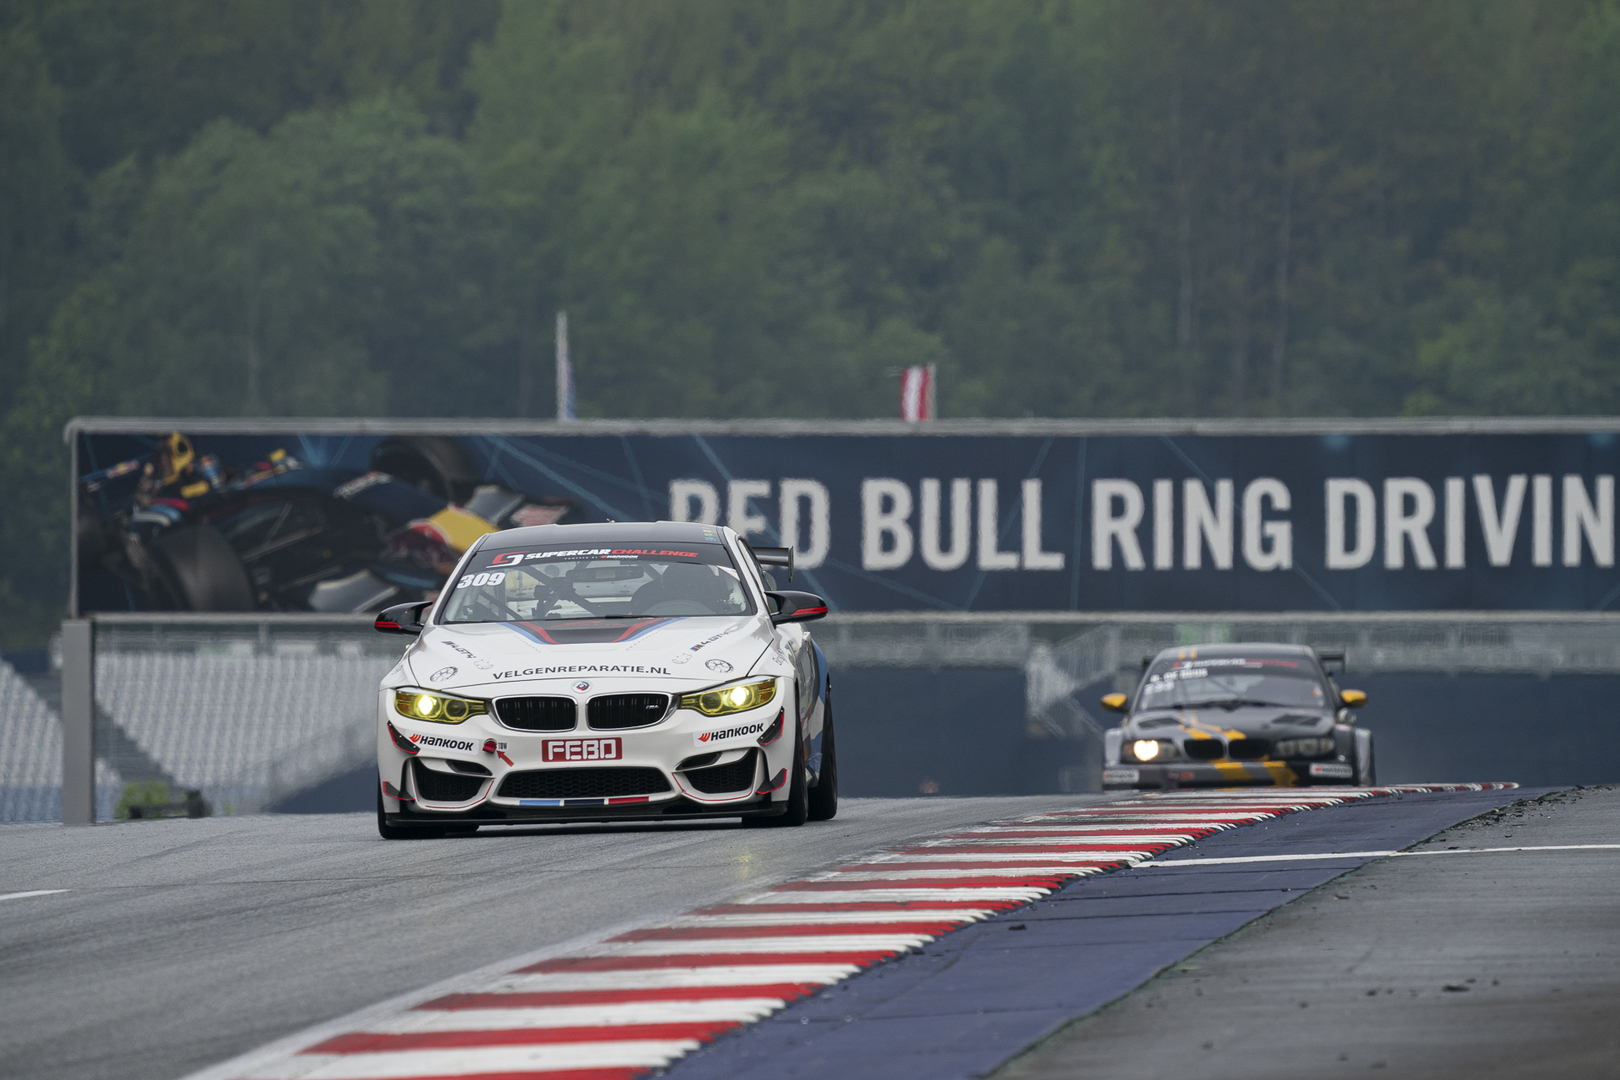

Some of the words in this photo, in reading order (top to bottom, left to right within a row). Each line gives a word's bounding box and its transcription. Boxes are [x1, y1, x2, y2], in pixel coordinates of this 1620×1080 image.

[860, 477, 1066, 571] BULL
[1091, 476, 1294, 572] RING
[1324, 474, 1616, 571] DRIVIN
[524, 548, 612, 561] SUPERCAR
[611, 548, 699, 559] CHALLENGE
[457, 572, 506, 589] 309
[492, 665, 672, 680] VELGENREPARATIE.NL
[548, 739, 616, 761] FEBO
